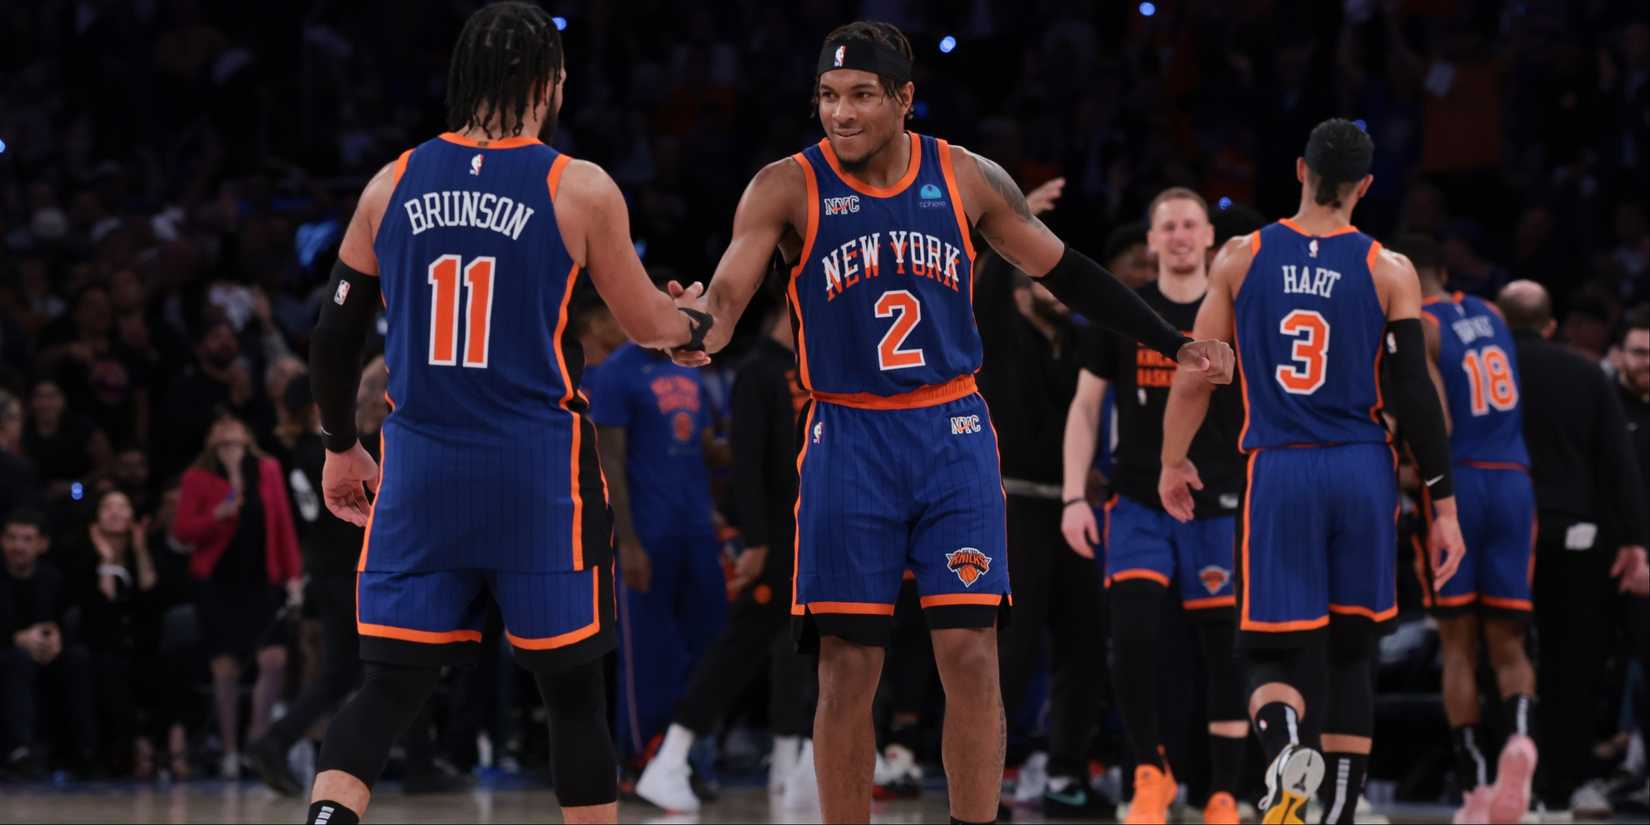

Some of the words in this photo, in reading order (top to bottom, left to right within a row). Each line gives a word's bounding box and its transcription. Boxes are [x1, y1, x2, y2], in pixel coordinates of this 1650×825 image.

[404, 190, 535, 240] BRUNSON
[824, 195, 860, 215] NYC
[822, 232, 881, 302] NEW
[889, 230, 960, 293] YORK
[1281, 264, 1341, 299] HART
[427, 253, 496, 369] 11
[874, 289, 926, 371] 2
[1275, 308, 1331, 395] 3
[1461, 344, 1519, 417] 18
[950, 414, 981, 435] NYC
